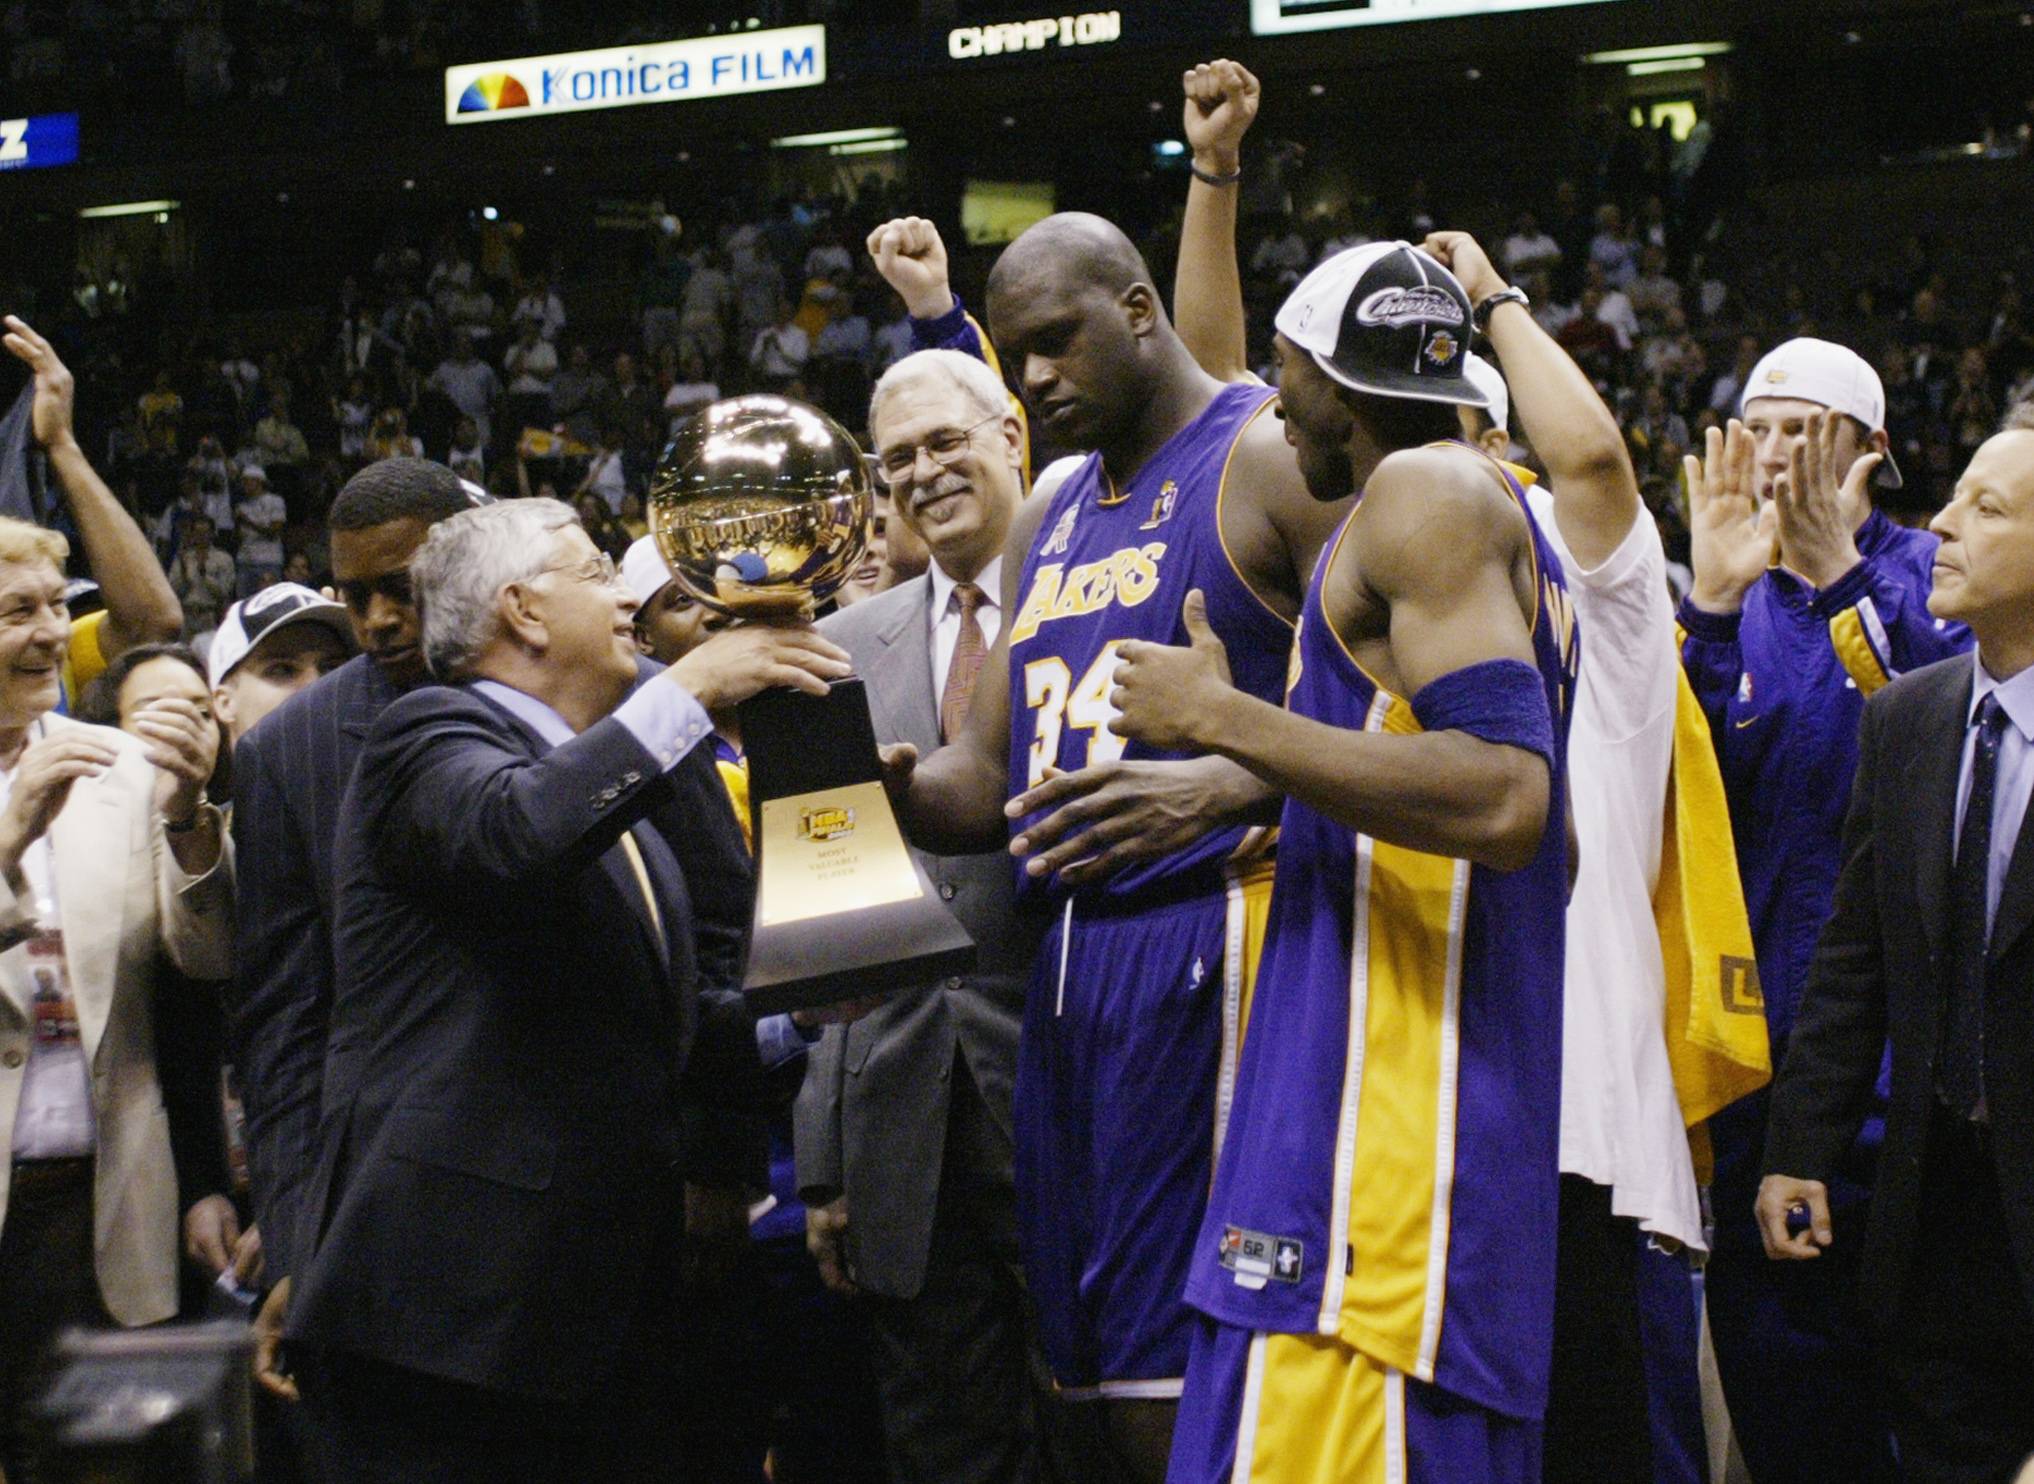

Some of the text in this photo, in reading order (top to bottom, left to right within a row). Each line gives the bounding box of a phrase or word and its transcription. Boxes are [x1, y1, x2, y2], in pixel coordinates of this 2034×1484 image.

[541, 46, 815, 105] Konica FILM
[949, 10, 1121, 59] CHAMPION
[1010, 542, 1168, 647] LAKERS
[1025, 638, 1129, 789] 34
